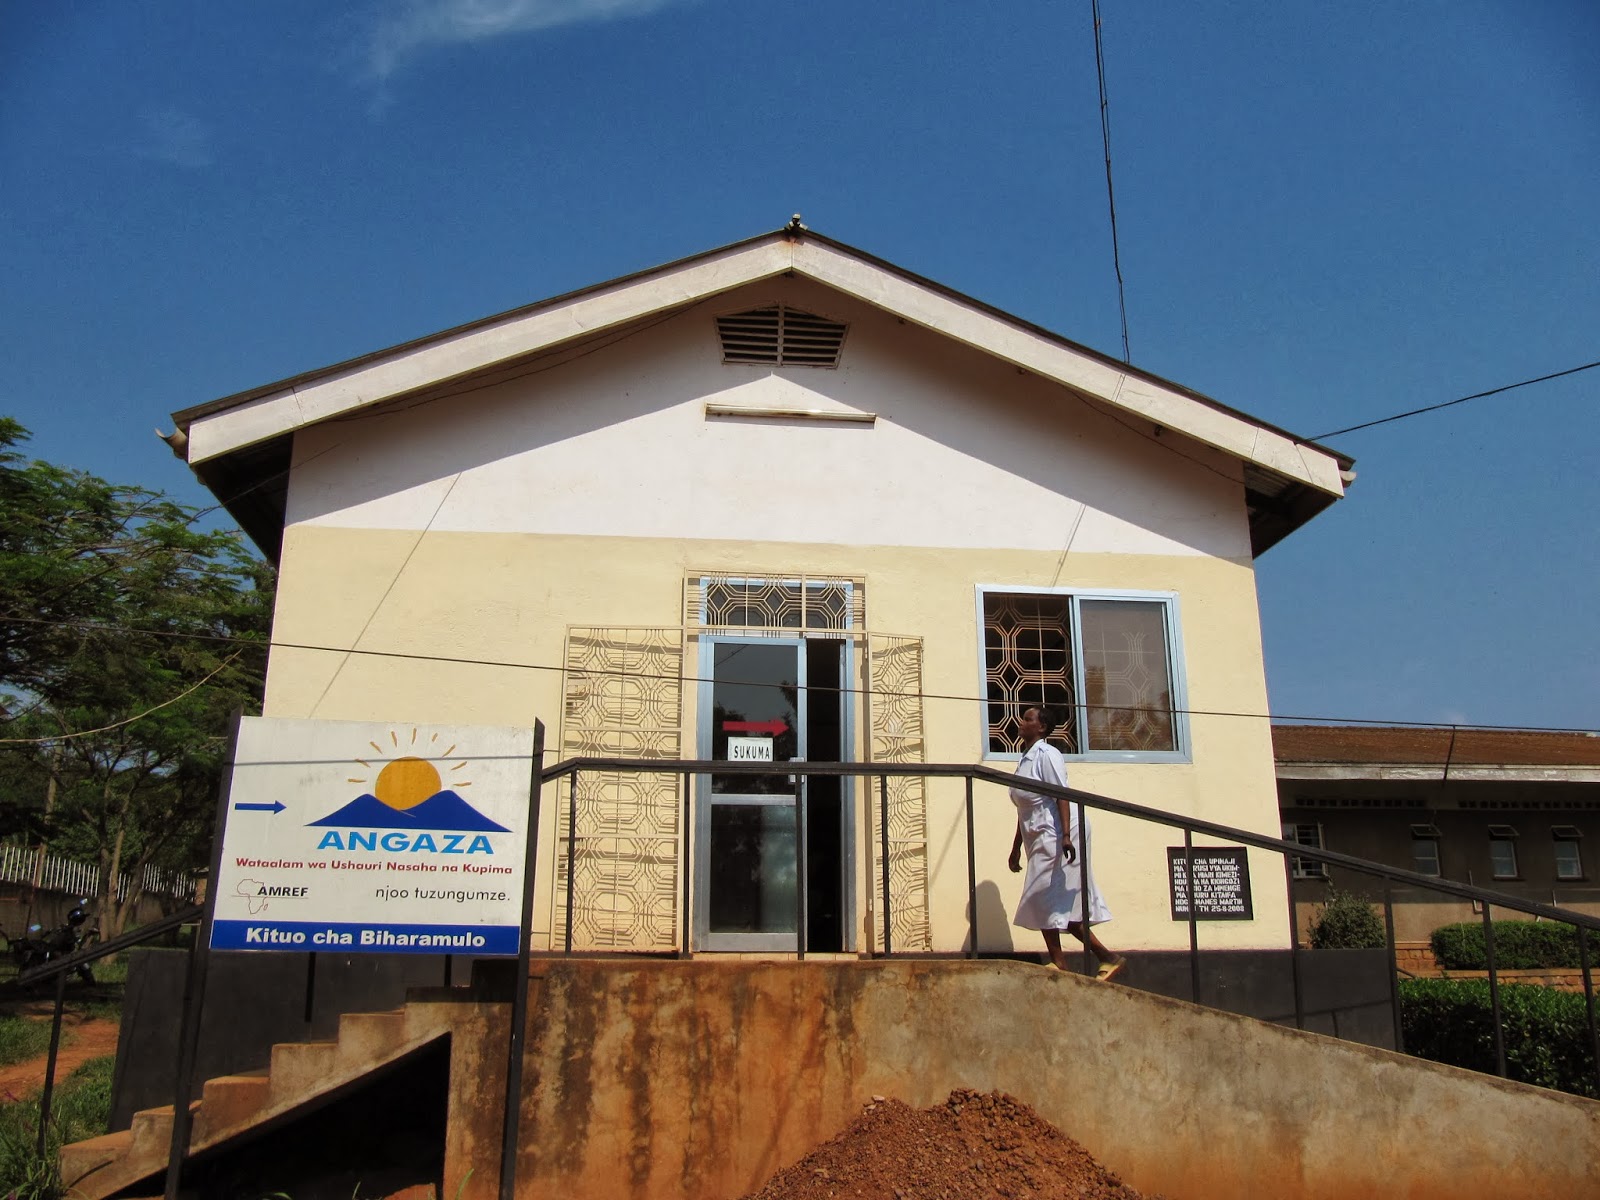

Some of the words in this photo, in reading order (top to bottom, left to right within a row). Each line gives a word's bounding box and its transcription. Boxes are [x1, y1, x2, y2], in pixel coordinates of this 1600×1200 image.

[734, 746, 770, 759] SUKUMA
[317, 831, 494, 854] ANGAZA
[236, 858, 303, 869] Wataalam
[308, 861, 326, 870] wa
[332, 860, 382, 870] Ushauri
[387, 861, 437, 872] Nasaha
[442, 864, 458, 873] na
[463, 863, 512, 875] Kupima
[258, 886, 308, 897] AMREF
[376, 885, 408, 901] njoo
[415, 887, 510, 903] tuzungumze.
[246, 928, 305, 944] Kituo
[313, 929, 352, 945] cha
[360, 930, 485, 947] Biharamulo
